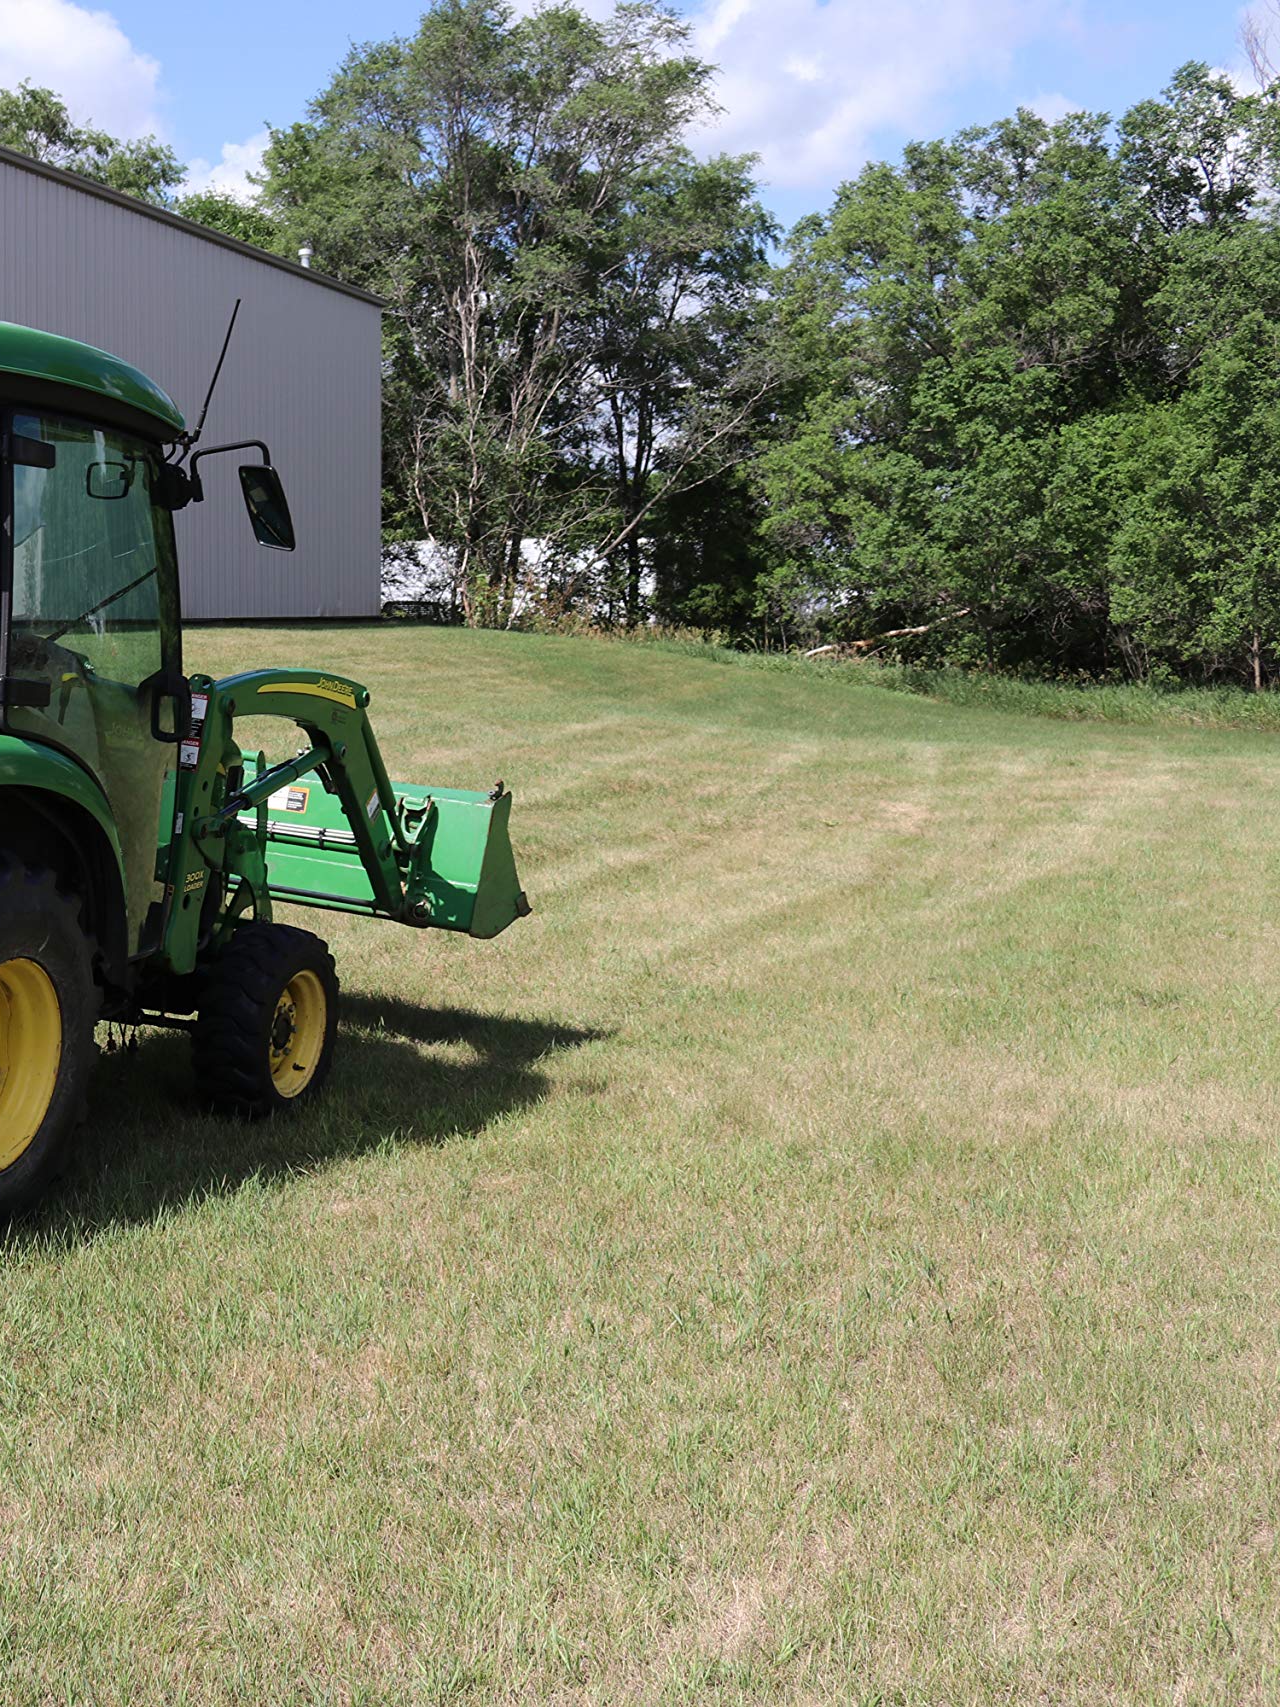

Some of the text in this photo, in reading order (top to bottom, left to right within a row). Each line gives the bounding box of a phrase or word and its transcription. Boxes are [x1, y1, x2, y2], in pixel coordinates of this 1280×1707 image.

[317, 677, 353, 696] JOHN DEERE
[185, 870, 204, 883] 300X
